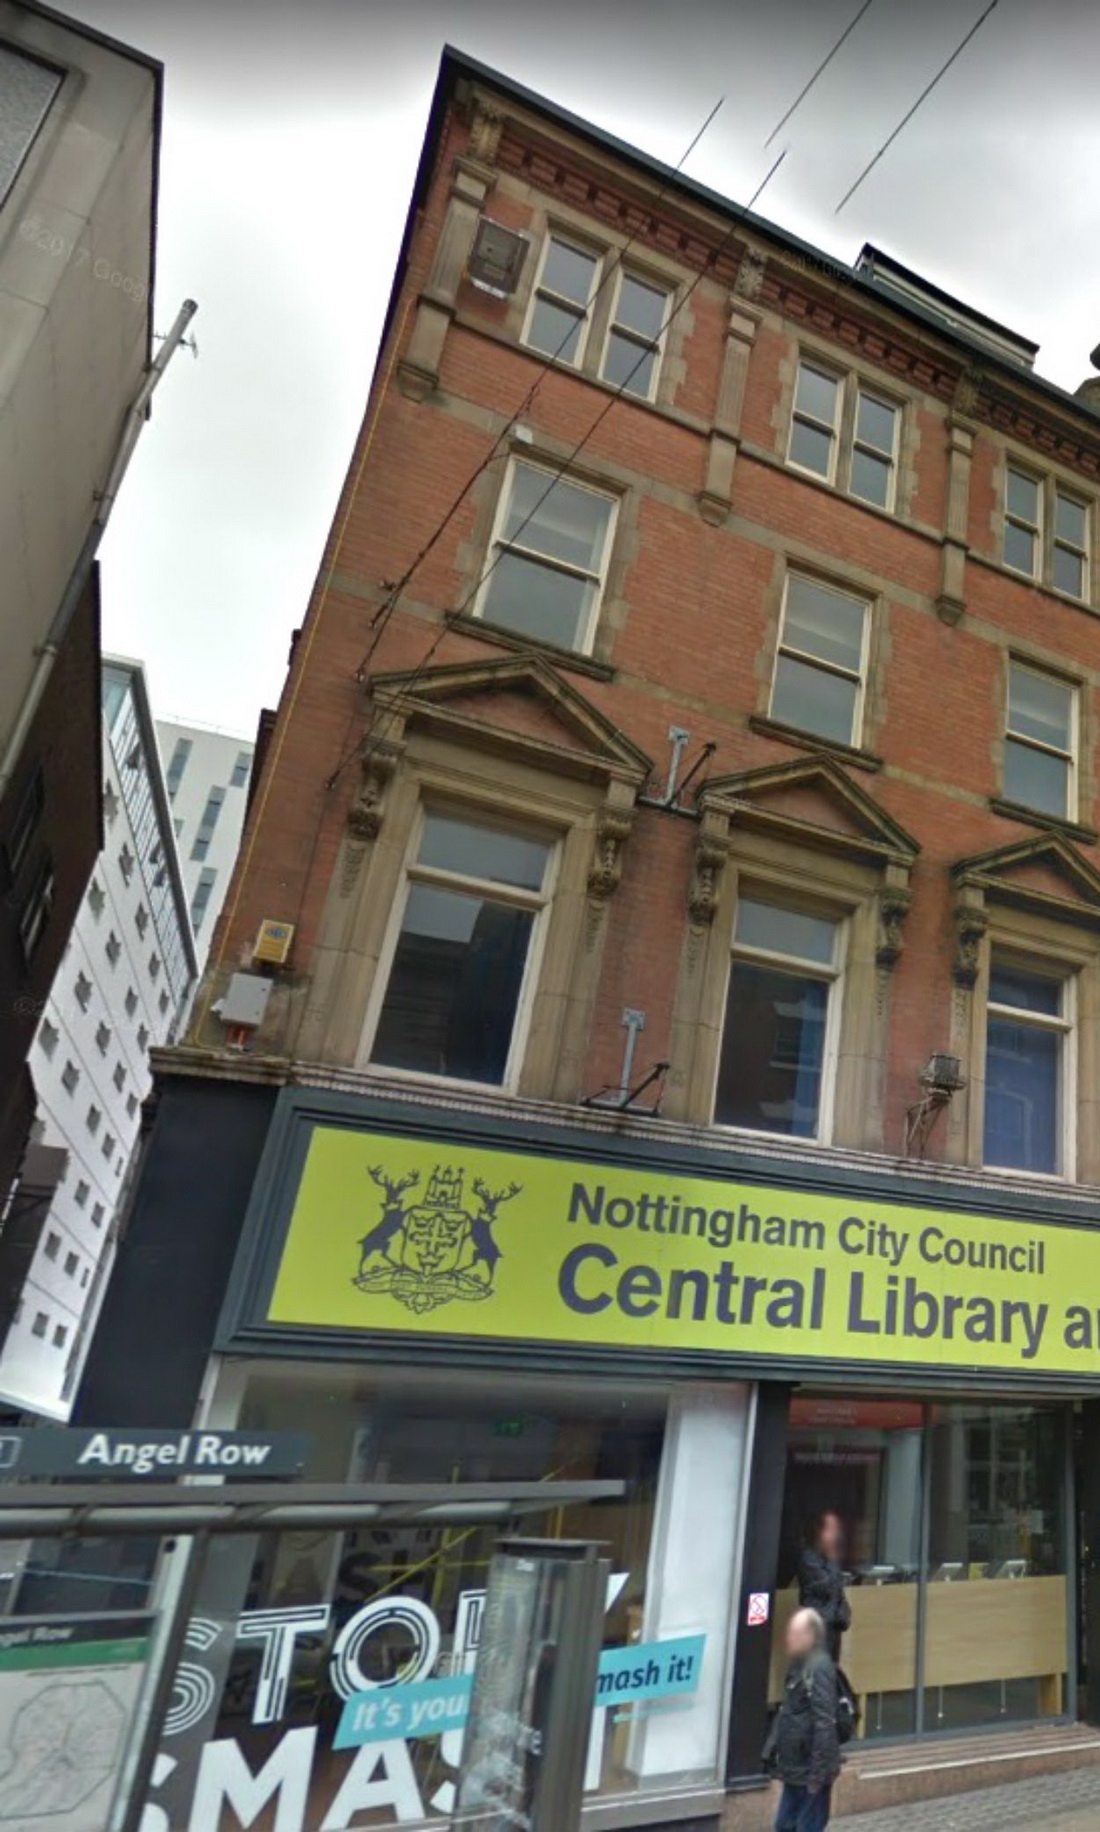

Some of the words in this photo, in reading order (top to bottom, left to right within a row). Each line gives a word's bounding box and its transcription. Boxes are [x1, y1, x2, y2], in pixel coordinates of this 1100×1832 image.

[567, 1182, 826, 1248] Nottingham
[837, 1215, 908, 1267] City
[918, 1225, 1045, 1272] Council
[559, 1242, 826, 1329] Central
[846, 1271, 1048, 1359] Library
[76, 1433, 191, 1474] Angel
[194, 1434, 272, 1465] Row
[352, 1697, 402, 1732] It's
[407, 1694, 470, 1732] you
[597, 1658, 661, 1694] mash
[667, 1654, 695, 1683] it!
